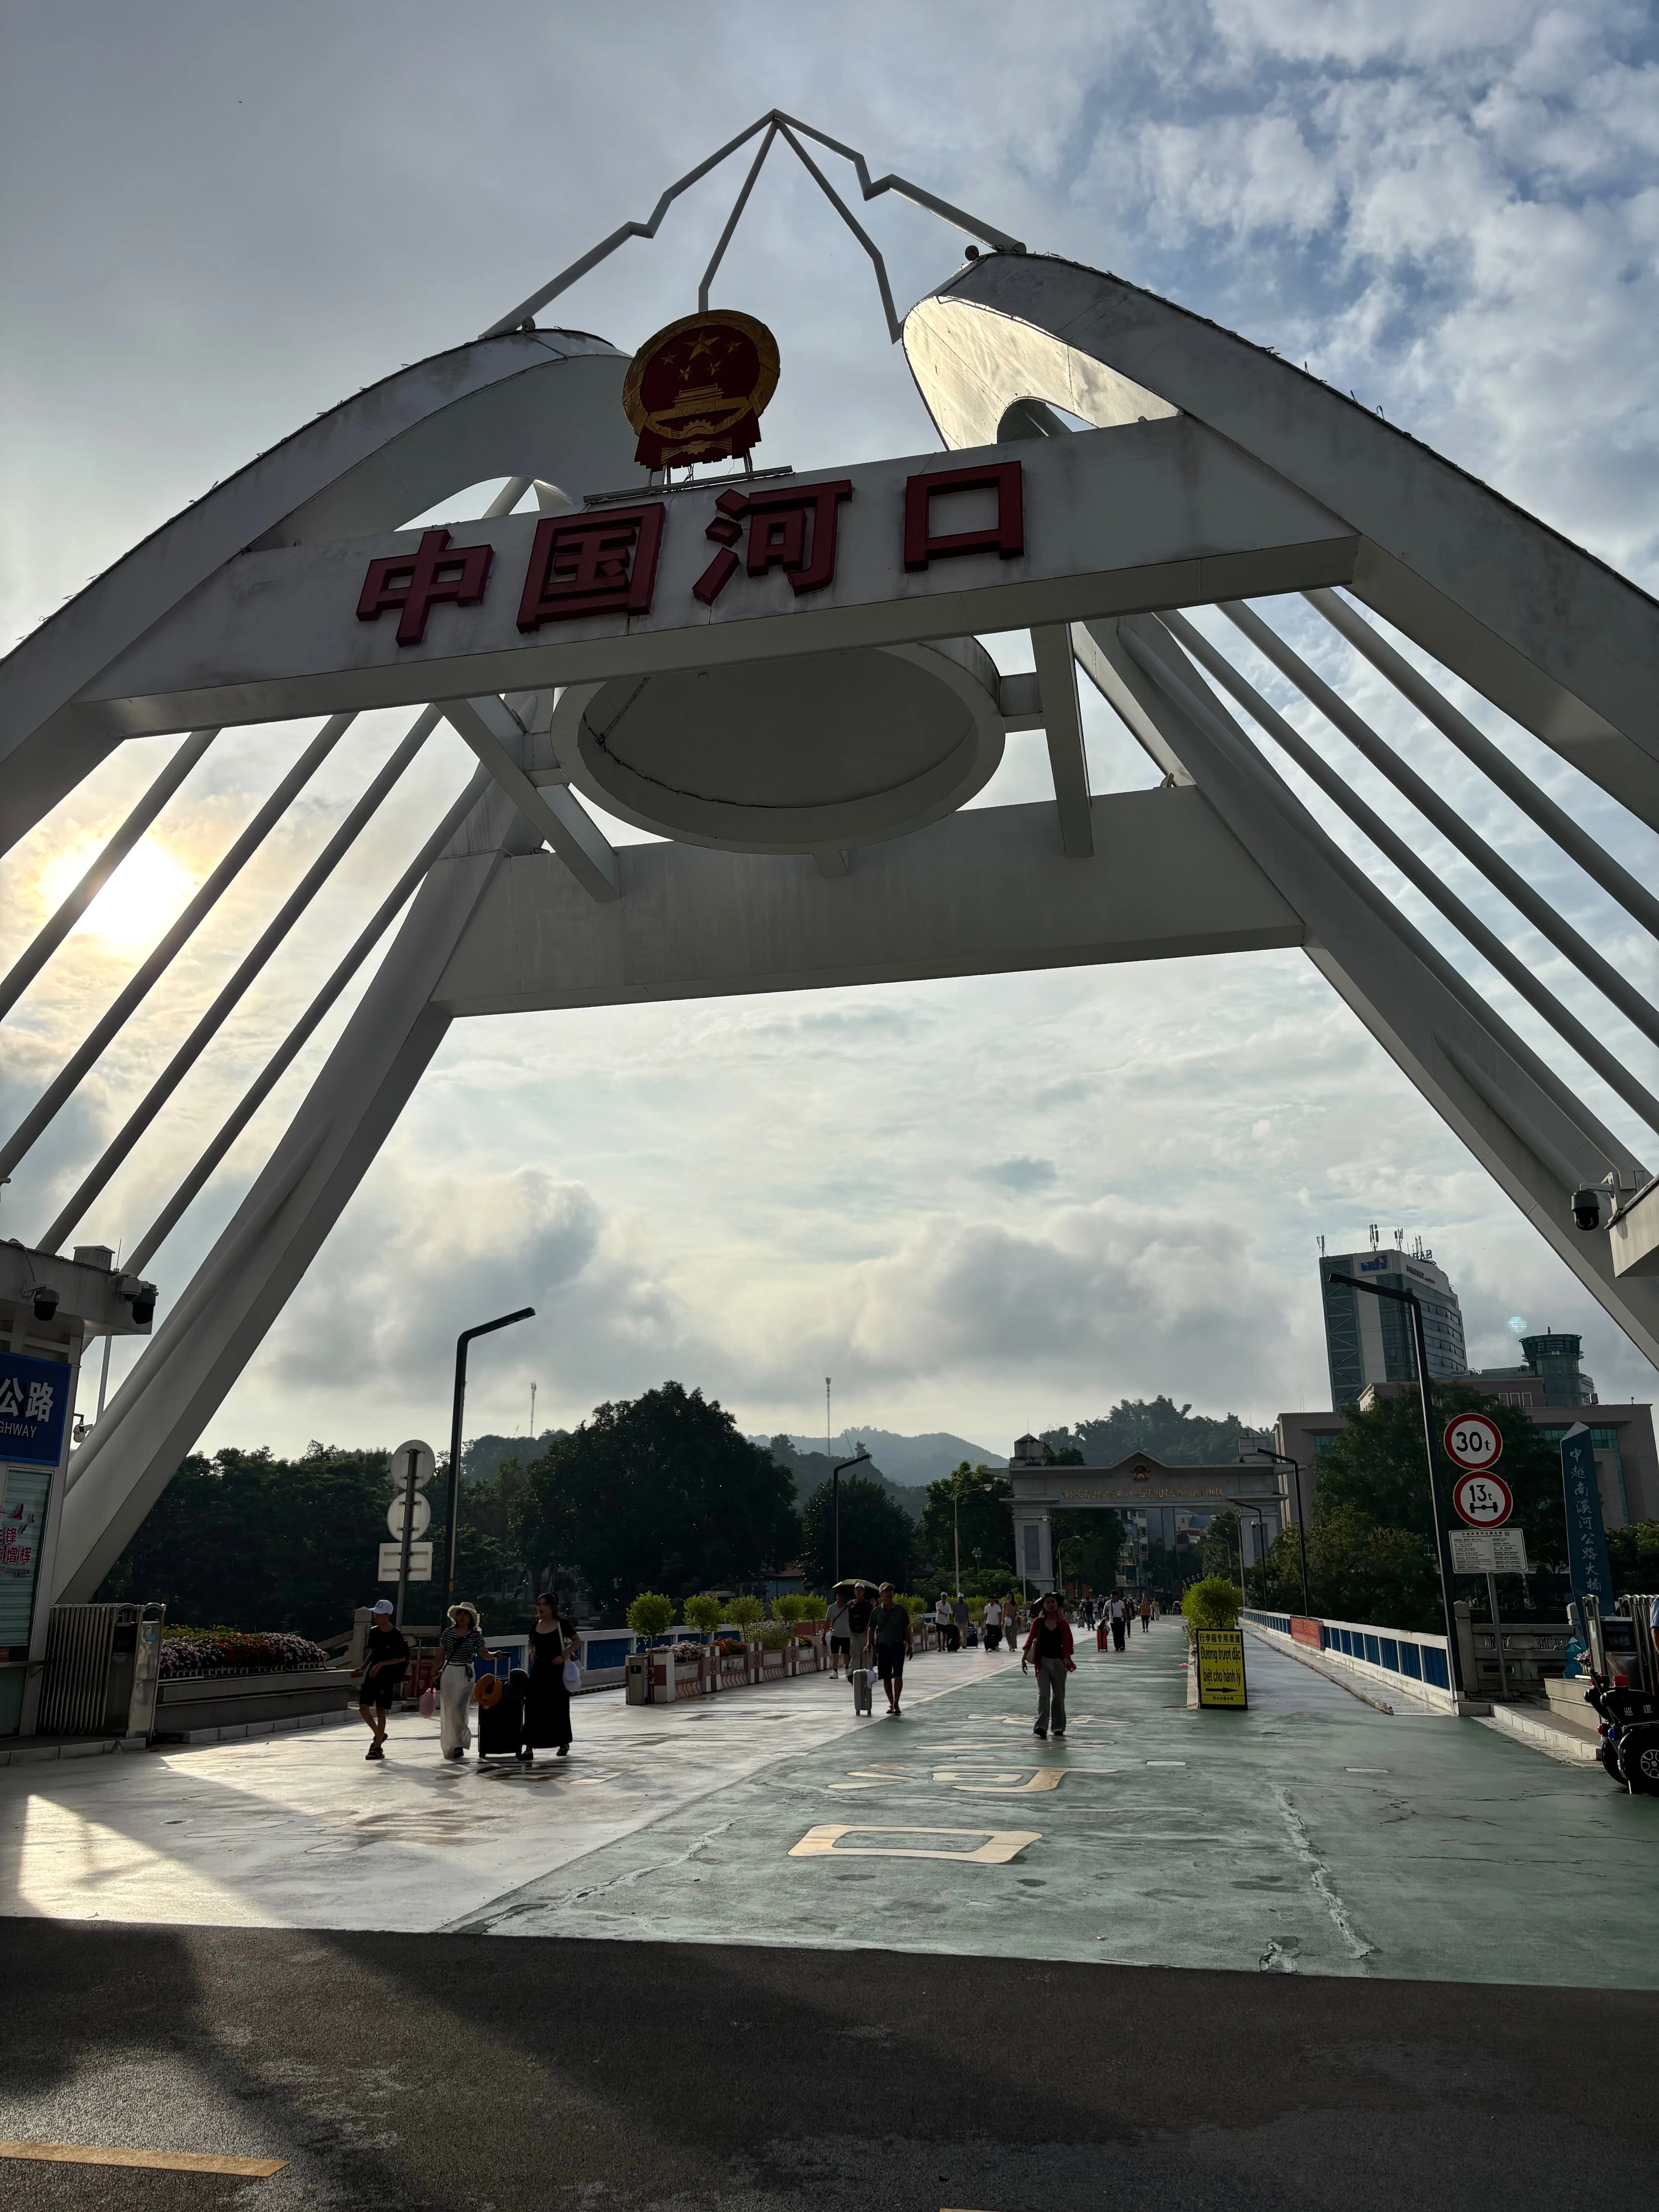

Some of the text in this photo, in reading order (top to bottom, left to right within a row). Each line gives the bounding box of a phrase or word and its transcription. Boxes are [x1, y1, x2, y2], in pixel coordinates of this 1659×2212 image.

[356, 460, 1025, 647] 中国河口
[0, 1377, 54, 1422] 公路
[1455, 1431, 1492, 1452] 30t
[1469, 1484, 1492, 1502] 13t
[1200, 1633, 1240, 1643] 行李箱专用滑道
[1213, 1668, 1222, 1683] cho
[1223, 1668, 1236, 1683] hành
